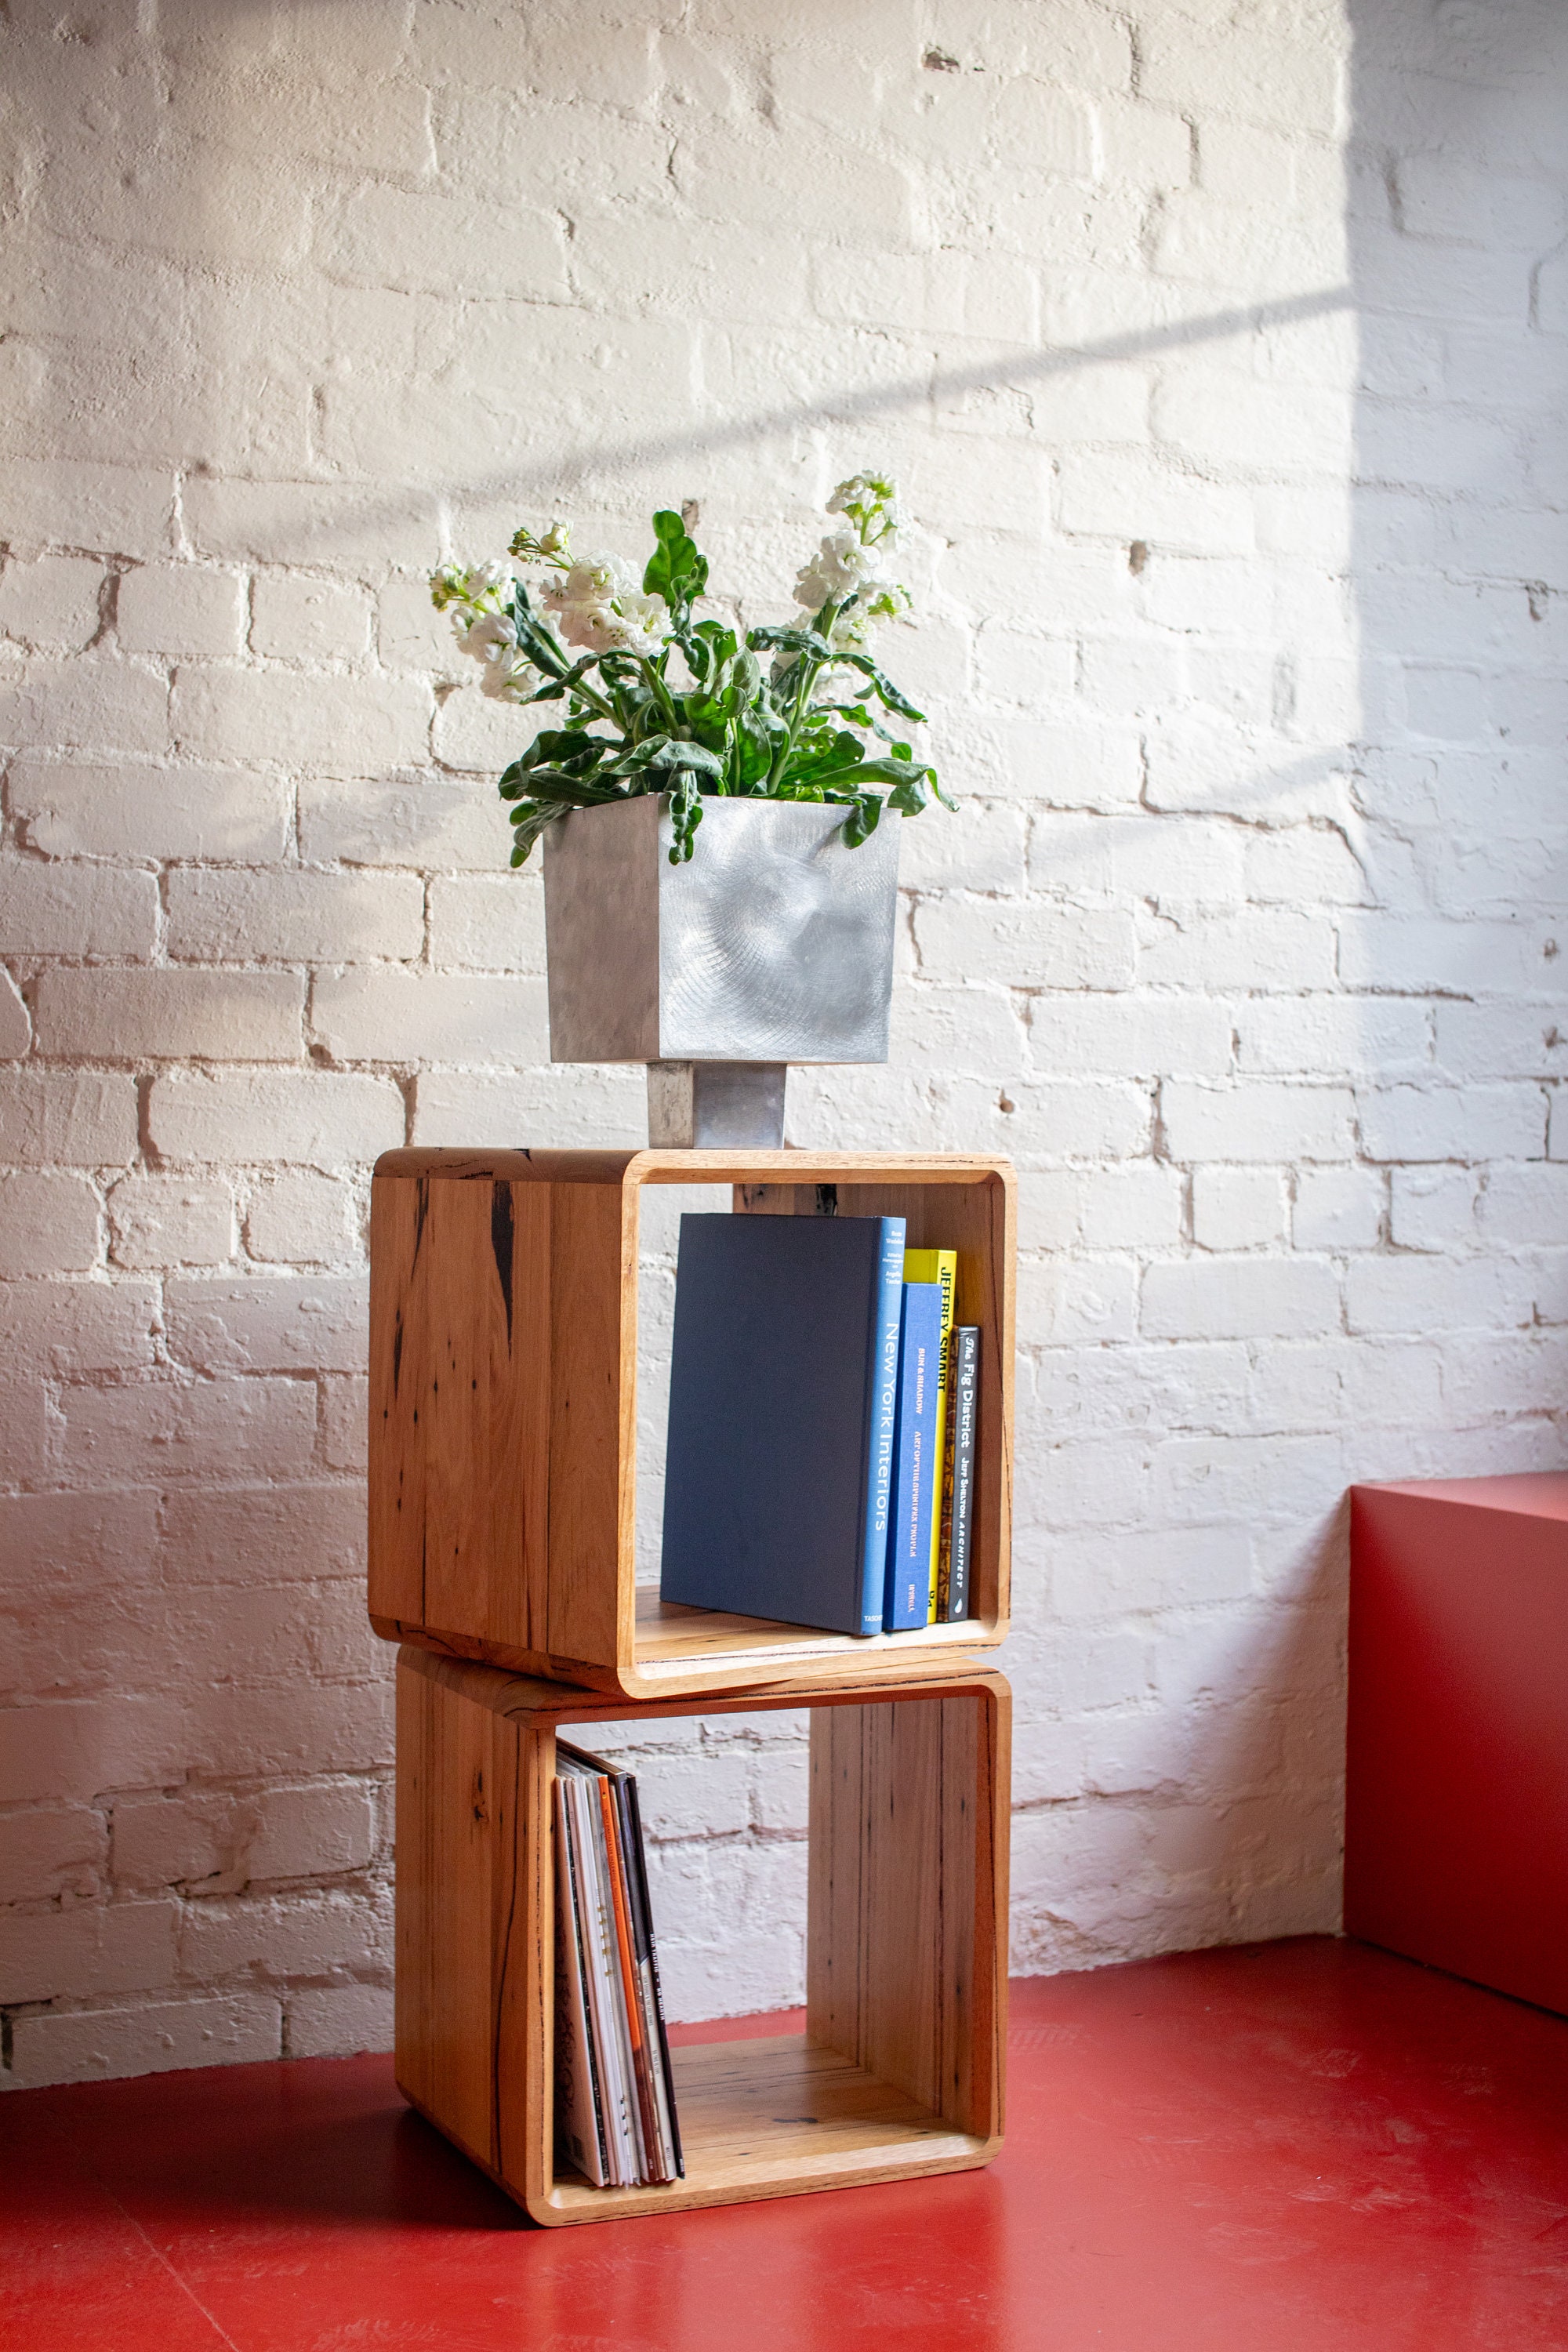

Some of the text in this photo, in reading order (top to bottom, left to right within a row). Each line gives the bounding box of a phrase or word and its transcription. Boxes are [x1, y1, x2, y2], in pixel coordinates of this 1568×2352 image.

[938, 1266, 951, 1392] JEFFREY SMART
[875, 1323, 899, 1531] New York Interiors
[915, 1374, 925, 1414] SHADOW
[961, 1338, 975, 1449] The Fig District
[913, 1450, 921, 1461] OF
[909, 1523, 918, 1557] PEOPLE
[956, 1521, 965, 1588] ARCHITECT
